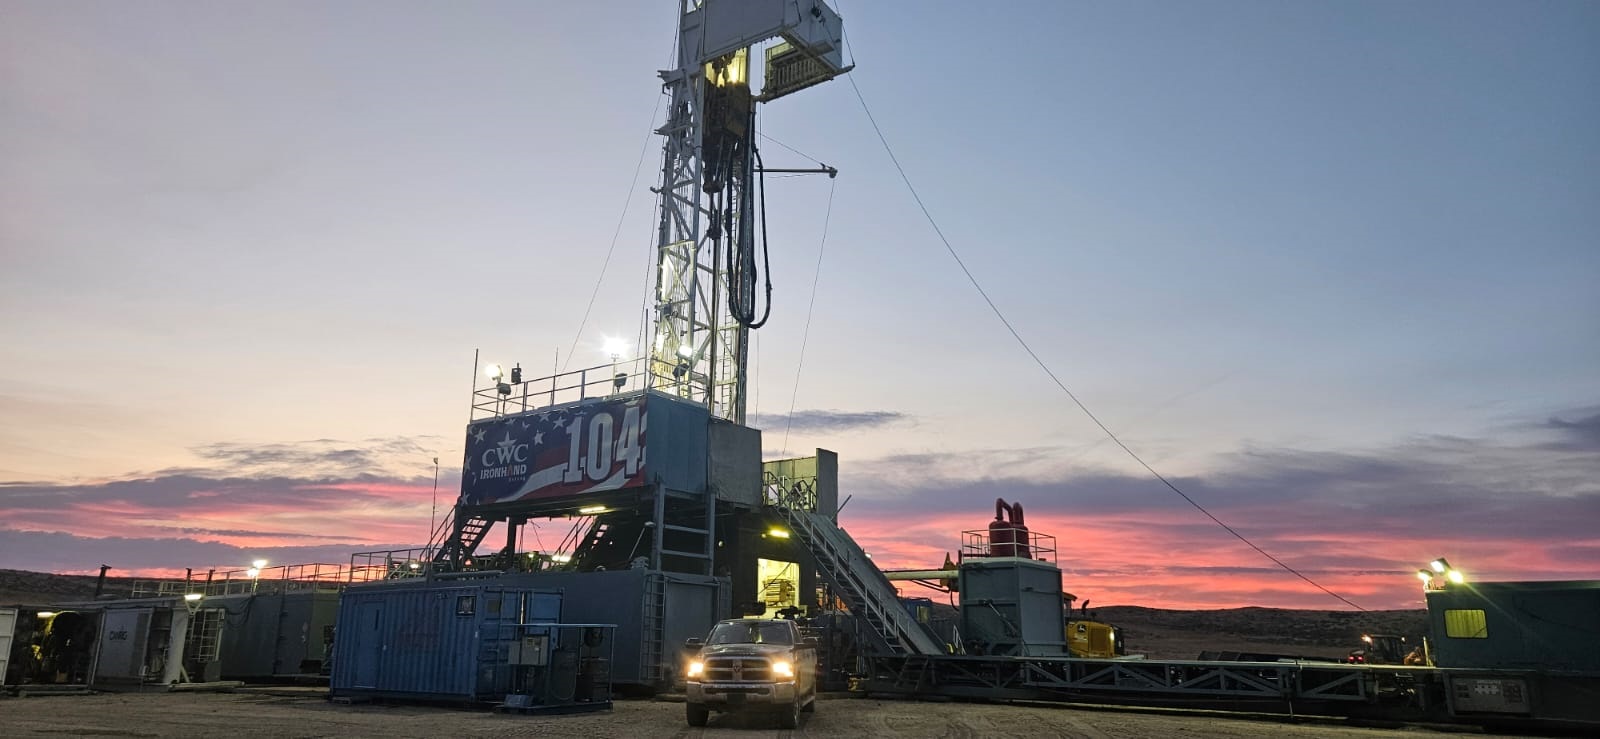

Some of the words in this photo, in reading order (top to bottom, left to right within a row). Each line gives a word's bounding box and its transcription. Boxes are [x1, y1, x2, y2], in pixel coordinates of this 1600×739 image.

[481, 443, 529, 467] CWC
[564, 406, 642, 483] 104
[480, 463, 527, 480] IRONHAND
